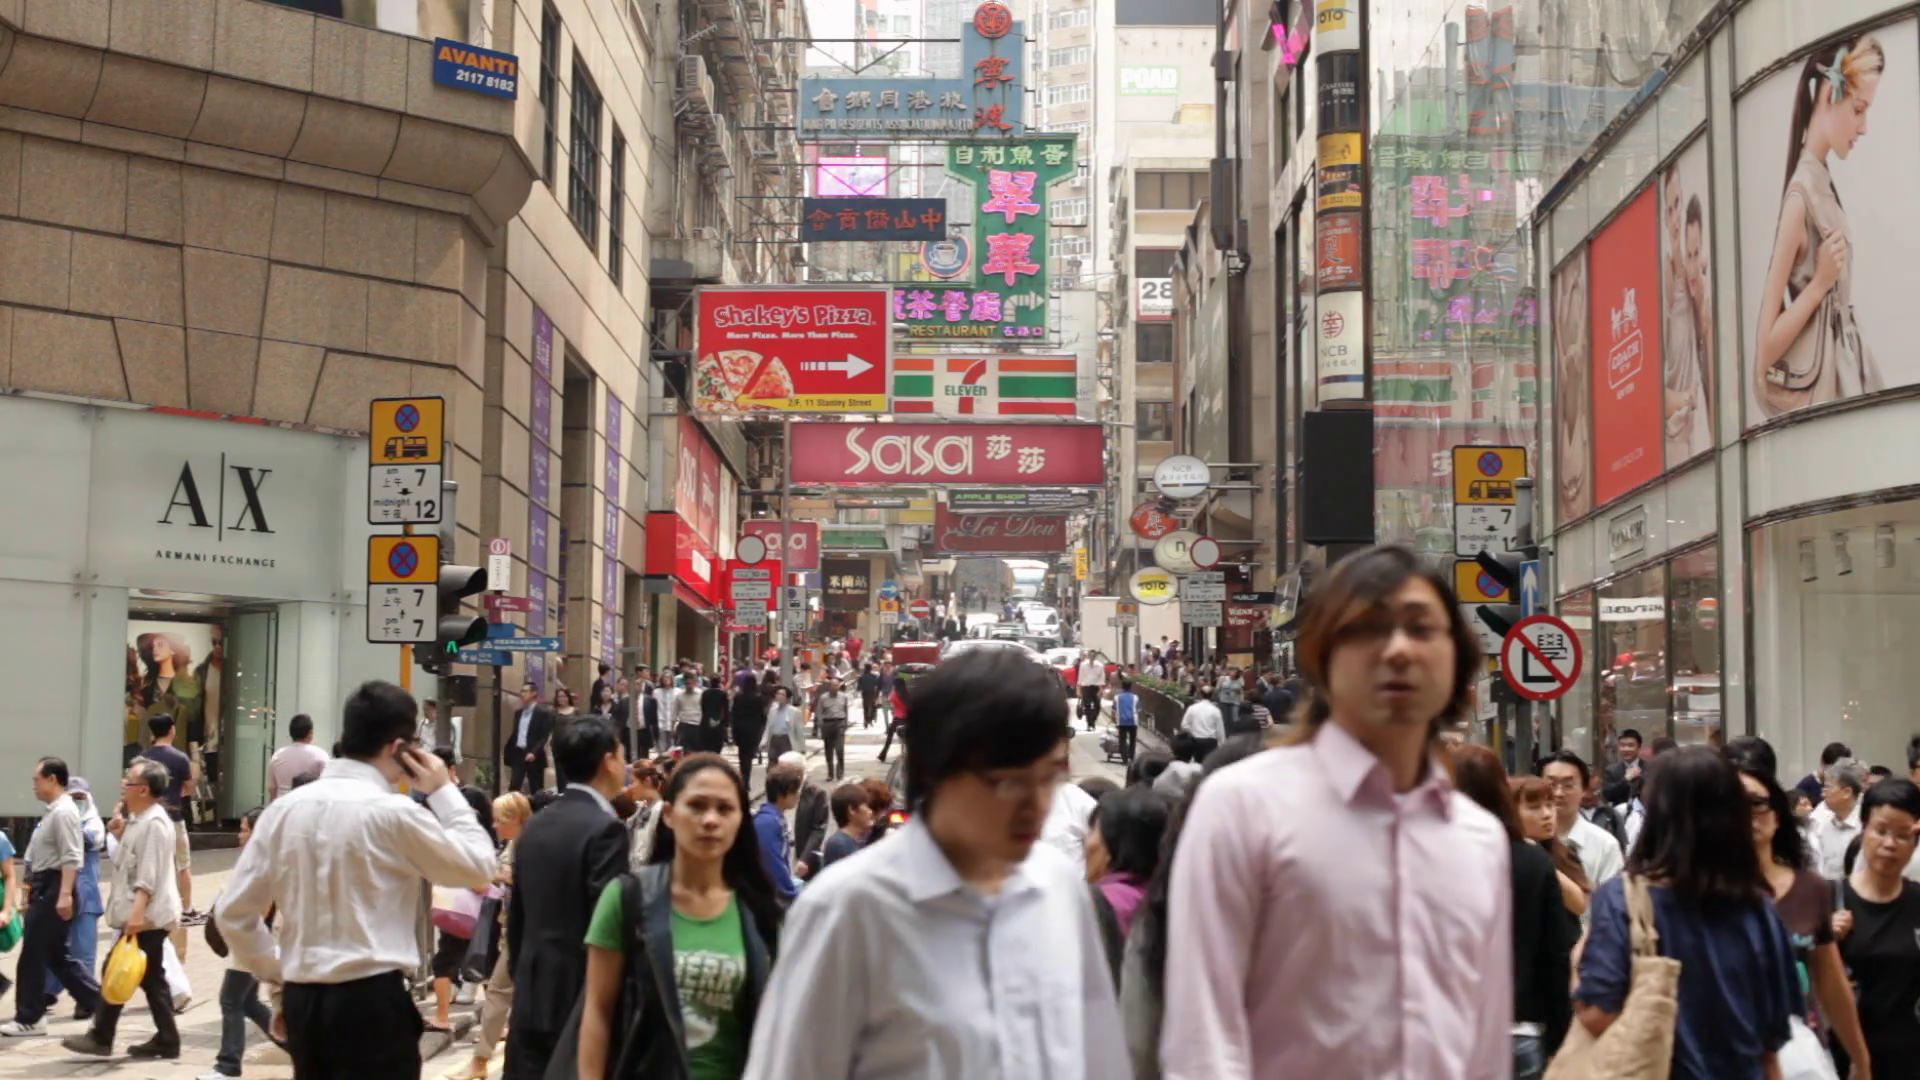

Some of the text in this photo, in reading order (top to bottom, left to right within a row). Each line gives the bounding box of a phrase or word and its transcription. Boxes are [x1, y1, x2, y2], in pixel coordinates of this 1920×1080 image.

[438, 45, 516, 76] AVANTI
[456, 69, 515, 92] 2117 8182
[1142, 281, 1173, 299] 28
[714, 304, 873, 328] Shakey's Pizza
[726, 331, 750, 339] More
[782, 331, 805, 339] More
[807, 331, 829, 339] Than
[909, 325, 997, 337] RESTAURANT
[805, 399, 814, 407] 11
[816, 399, 846, 408] Stanley
[847, 399, 872, 407] Street
[986, 434, 1045, 474] 莎莎
[414, 468, 426, 487] 7
[373, 498, 436, 518] midnight 12
[1500, 508, 1512, 525] 7
[156, 550, 277, 569] ARMANI EXCHANGE
[413, 588, 425, 607] 7
[413, 619, 424, 638] 7
